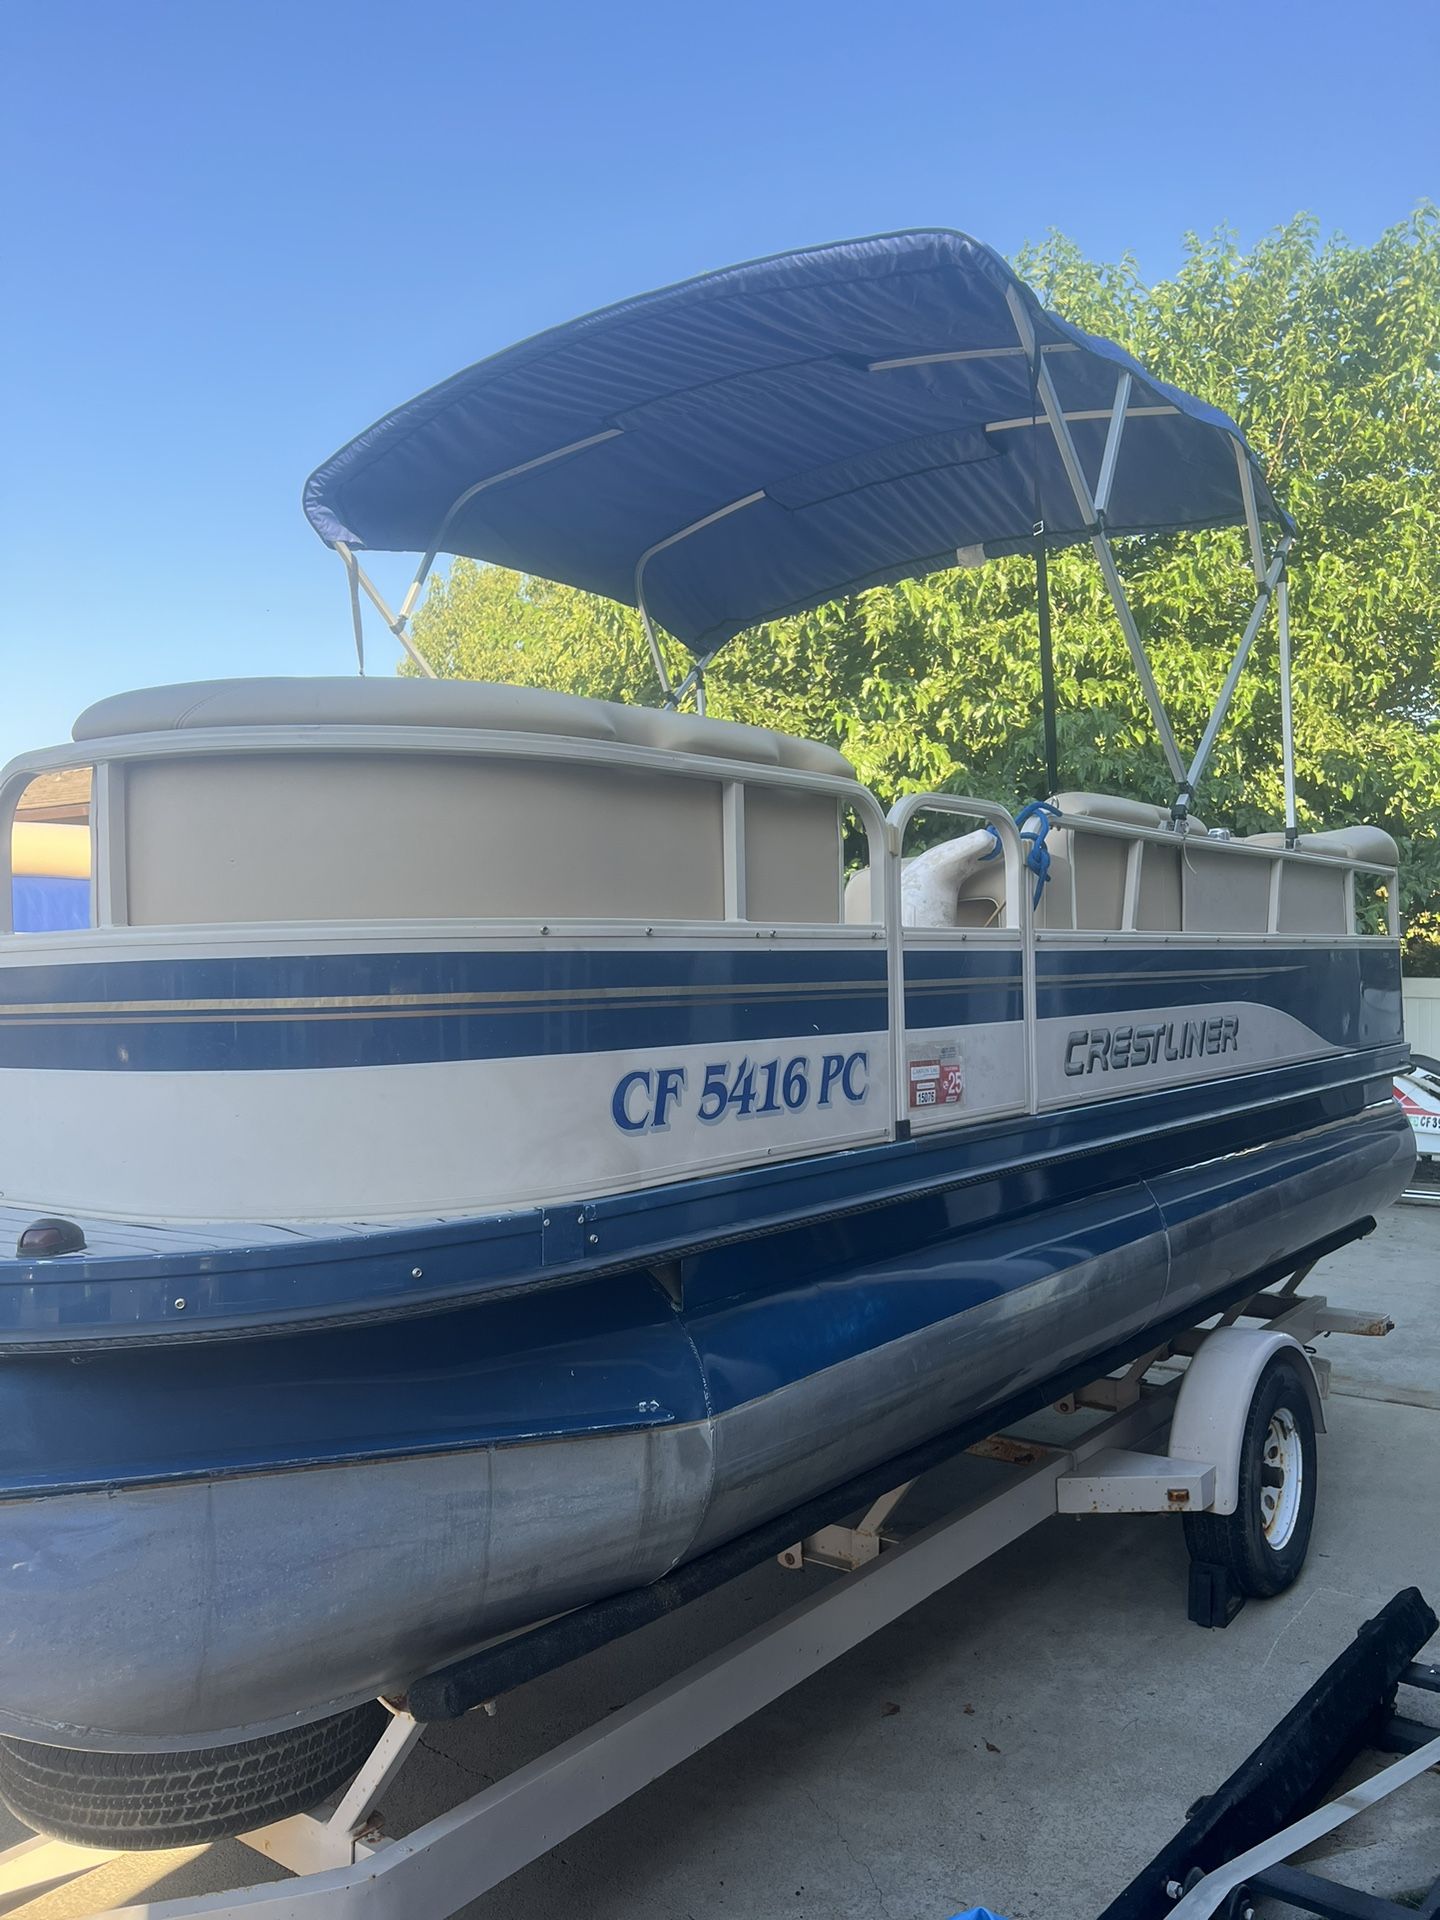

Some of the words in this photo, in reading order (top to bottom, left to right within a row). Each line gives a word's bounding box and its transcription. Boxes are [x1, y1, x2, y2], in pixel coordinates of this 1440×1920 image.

[1064, 1015, 1239, 1077] CRESTLINER
[611, 1067, 687, 1133] CF
[697, 1056, 809, 1123] 5416
[817, 1052, 869, 1106] PC
[948, 1072, 962, 1094] 25
[1420, 1116, 1431, 1128] CF
